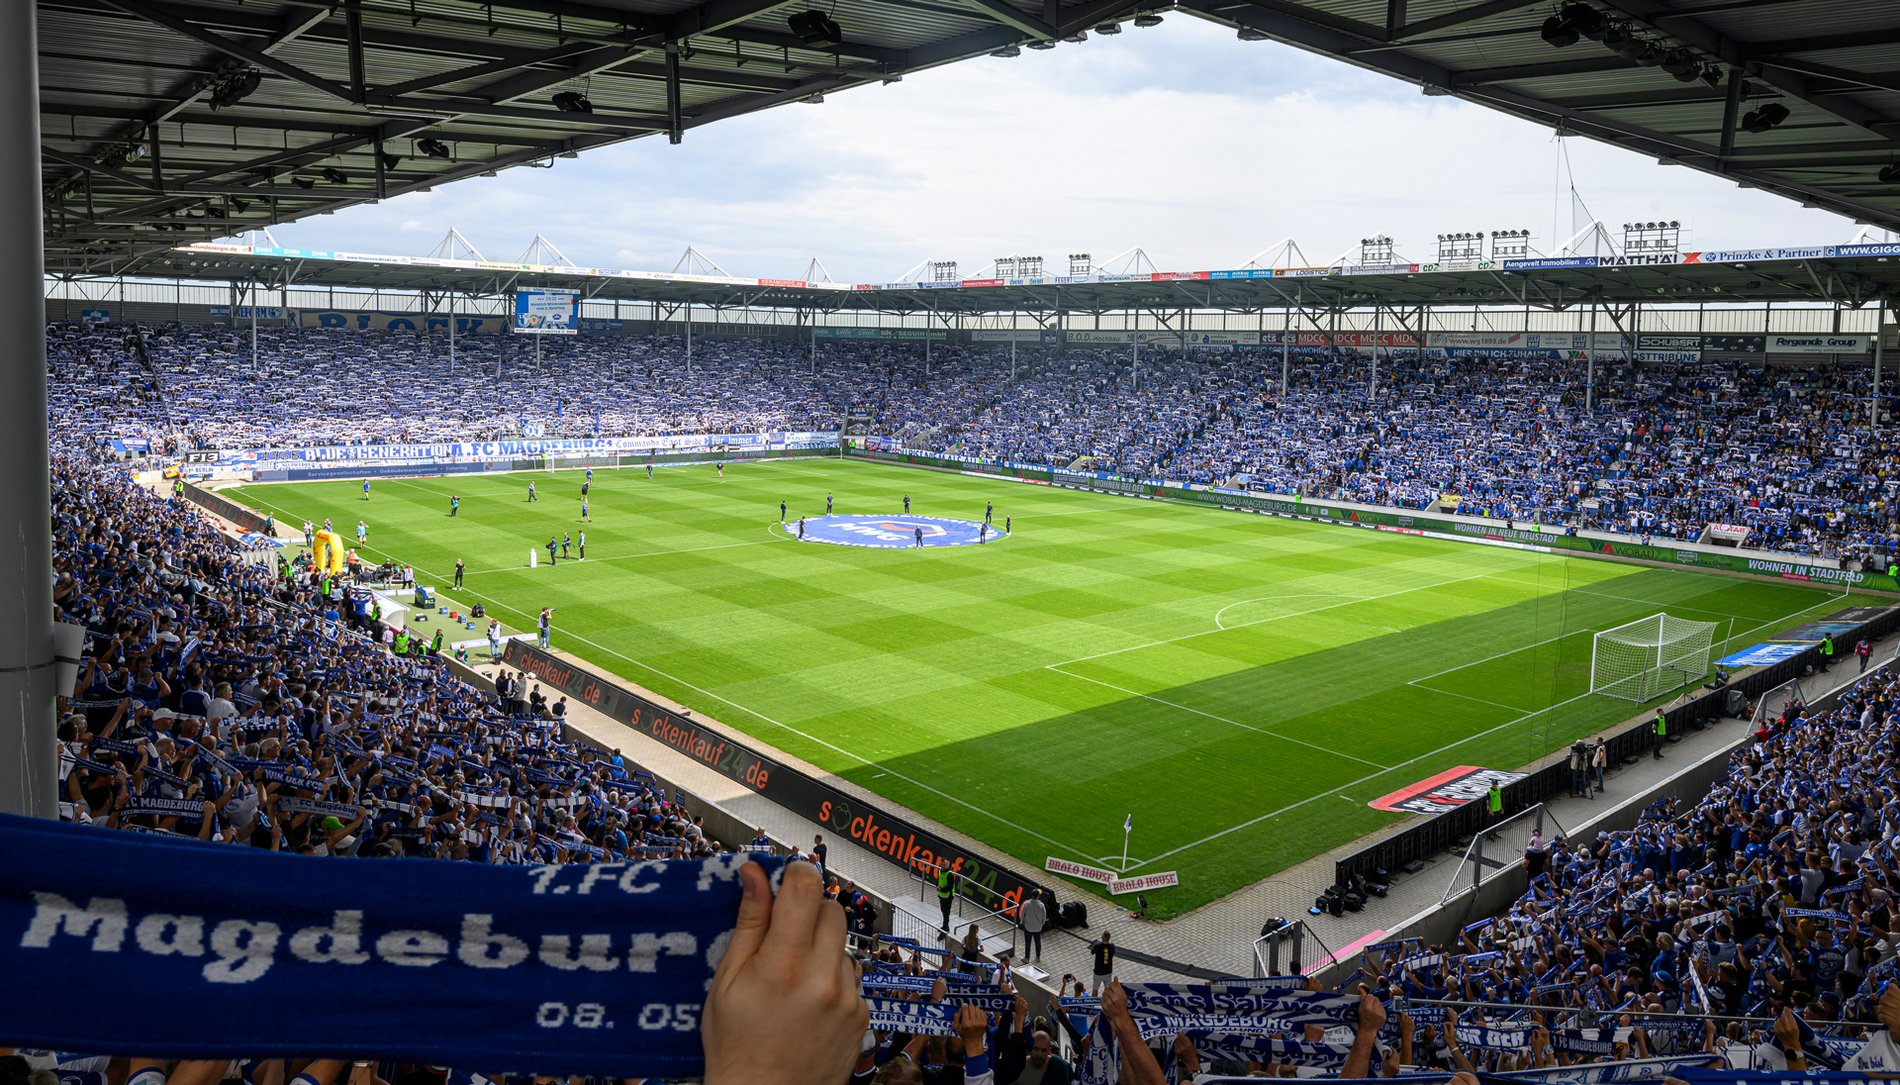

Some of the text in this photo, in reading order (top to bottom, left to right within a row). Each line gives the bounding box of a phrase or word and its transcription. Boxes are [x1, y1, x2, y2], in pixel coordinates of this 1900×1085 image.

[1600, 254, 1678, 266] MATTHÄI
[1720, 248, 1822, 261] Prinzke & Partner
[1506, 258, 1580, 268] Aengevelt Immobilien
[1300, 334, 1325, 343] MDCC
[1450, 338, 1507, 346] www.wg1893.de
[1640, 336, 1700, 347] SCHUBERT
[1776, 338, 1856, 348] Pergande Group
[500, 439, 609, 455] MAGDEBURG
[615, 437, 702, 448] Commando East Side
[712, 435, 752, 445] für immer
[306, 444, 450, 460] BLUE GENERATION
[380, 466, 438, 474] Gebäudemanagement
[1094, 479, 1121, 490] WOHNEN
[1122, 482, 1131, 491] BEI
[1132, 484, 1145, 493] DER
[1196, 492, 1297, 513] WWW.WOBAU-MAGDEBURG.DE
[1454, 522, 1558, 544] WOHNEN IN NEUE NEUSTADT
[1614, 546, 1655, 560] WOBAU
[1748, 559, 1793, 574] WOHNEN
[1795, 564, 1808, 576] IN
[1809, 567, 1864, 583] STADTFELD
[140, 798, 204, 812] MAGDEBURG
[314, 802, 360, 814] Magdebur
[1048, 860, 1114, 882] BRALO HOUSE
[1112, 873, 1176, 892] BRALO HOUSE
[1214, 992, 1359, 1021] Salzwede
[904, 1024, 940, 1036] FÜR
[1136, 1015, 1294, 1032] FC MAGDEBURG
[1558, 1037, 1568, 1048] FC
[1568, 1038, 1613, 1053] MAGDEBURG
